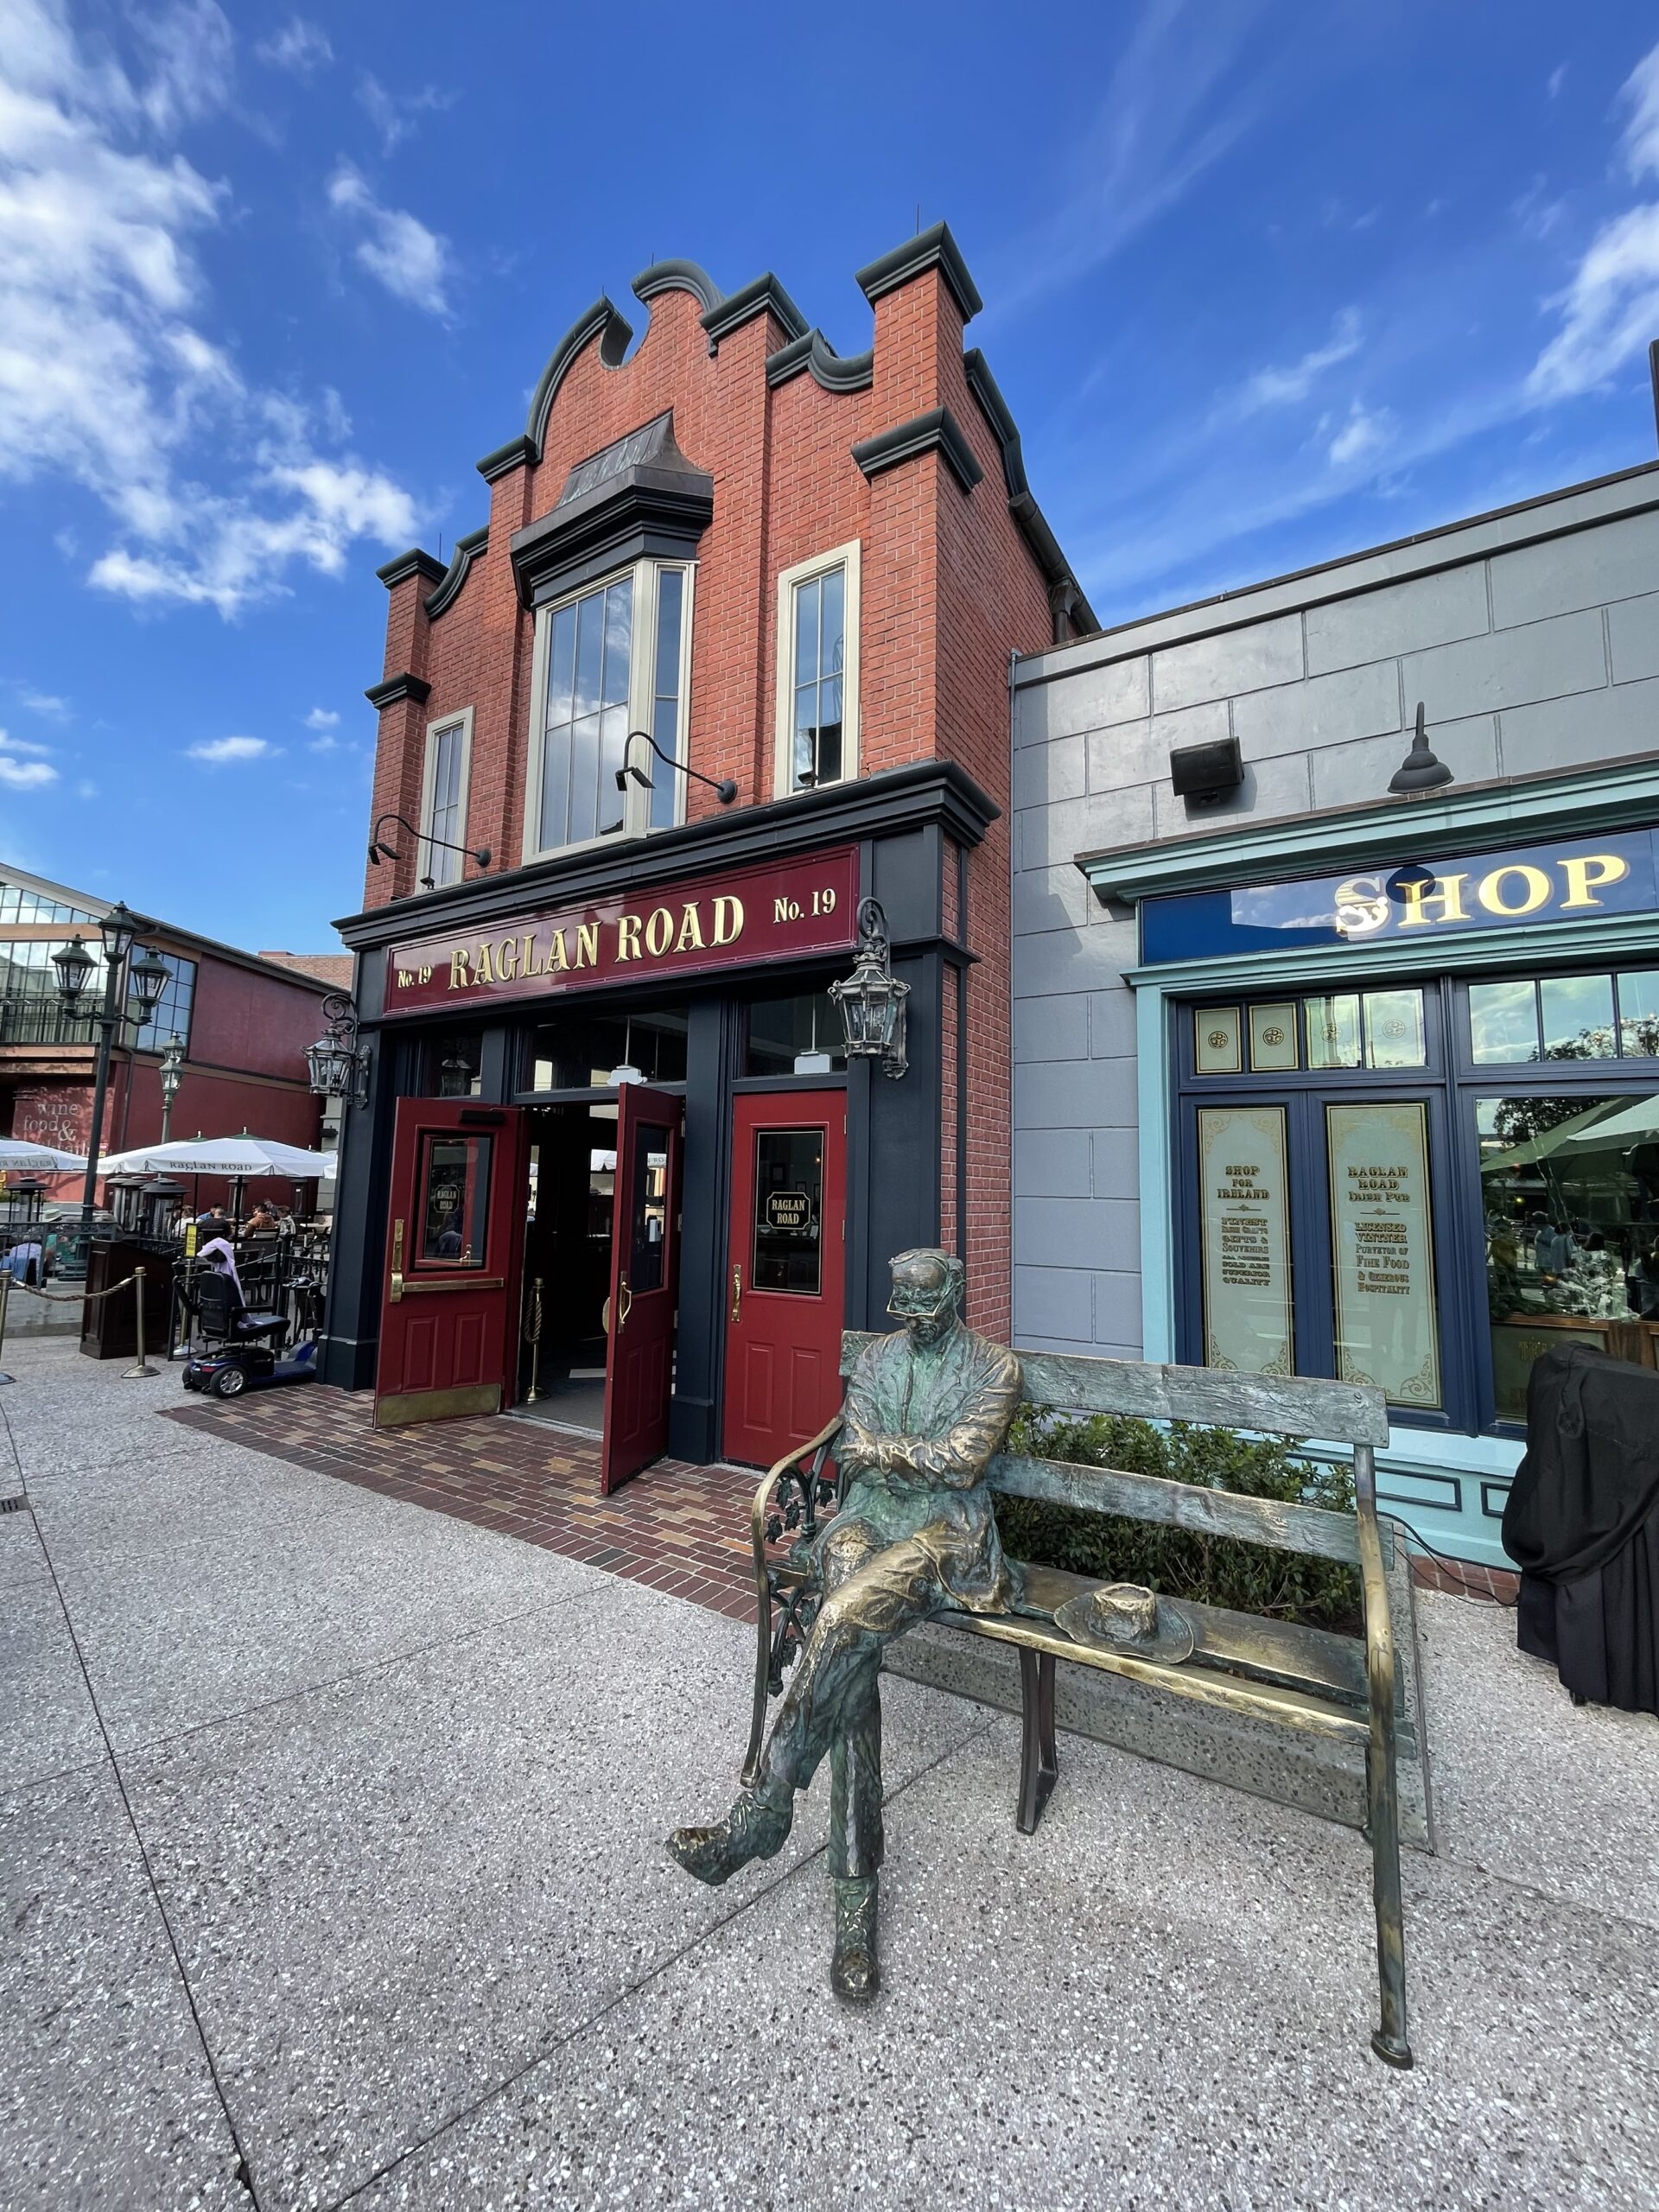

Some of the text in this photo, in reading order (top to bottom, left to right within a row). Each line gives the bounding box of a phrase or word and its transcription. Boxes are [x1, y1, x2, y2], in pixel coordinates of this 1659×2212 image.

[1335, 855, 1631, 938] SHOP
[397, 888, 837, 991] No. 19 RAGLAN ROAD No. 19
[37, 1103, 79, 1116] wine
[23, 1115, 78, 1141] food &
[1225, 1166, 1261, 1176] SHOP
[1348, 1166, 1408, 1178] RAGLAN
[1231, 1179, 1254, 1187] FOR
[1358, 1179, 1400, 1190] ROAD
[1217, 1188, 1270, 1200] IRELAND
[772, 1199, 805, 1211] RAGLAN
[776, 1212, 800, 1224] ROAD
[1354, 1222, 1408, 1233] LICENSED
[1382, 1255, 1410, 1269] FOOD
